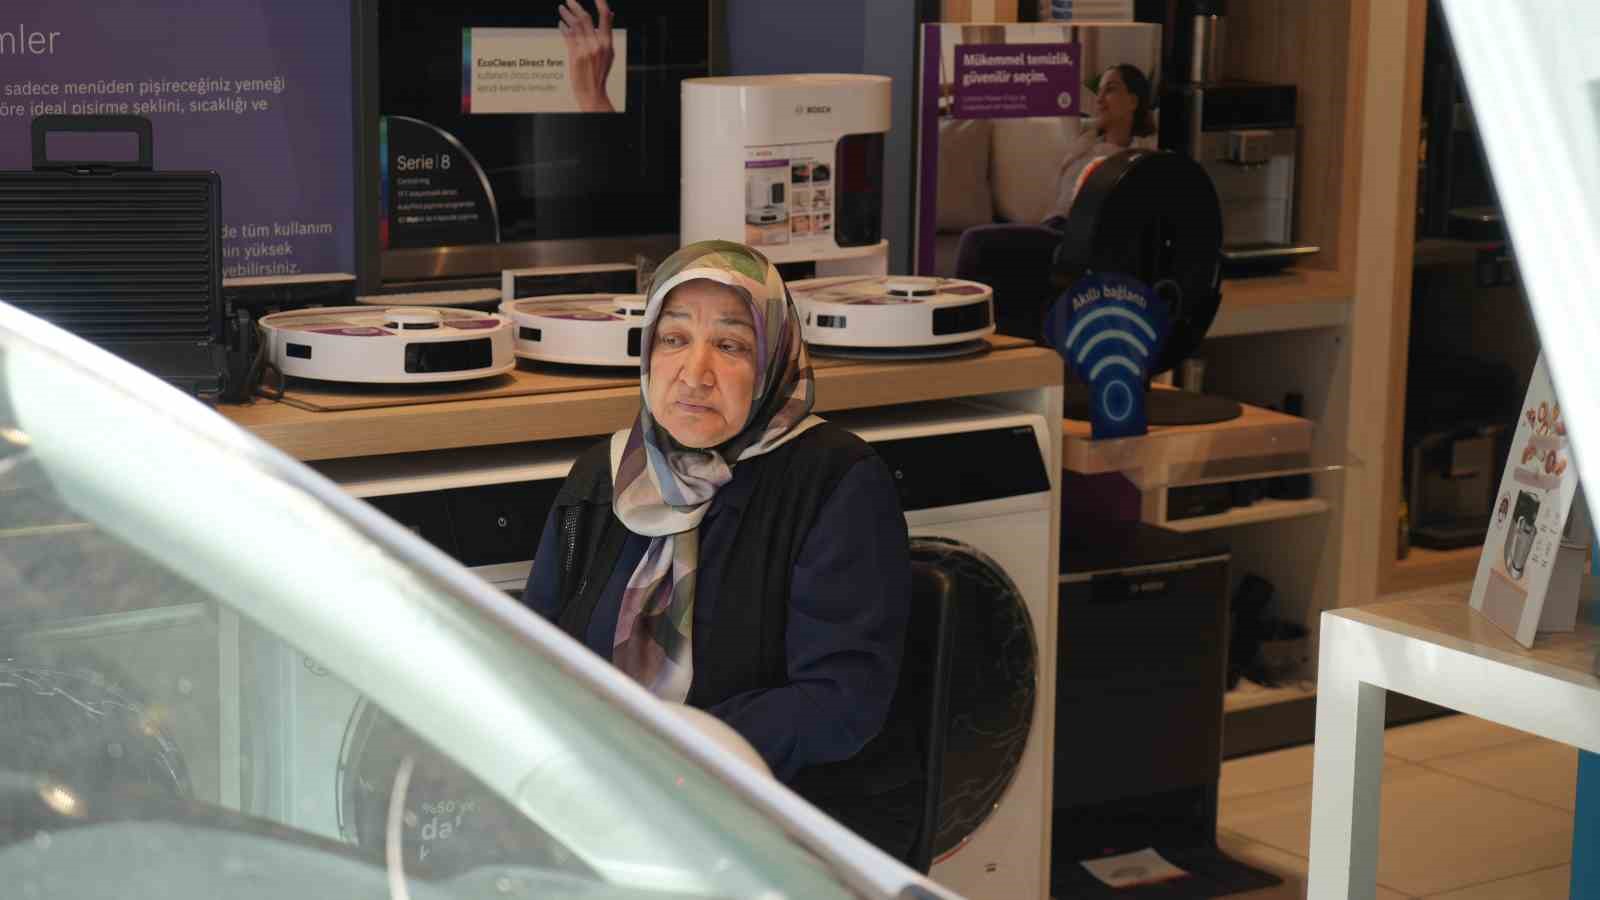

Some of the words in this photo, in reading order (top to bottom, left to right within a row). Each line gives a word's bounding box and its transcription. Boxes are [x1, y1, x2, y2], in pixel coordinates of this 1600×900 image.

[519, 57, 545, 68] Direct
[963, 52, 1025, 66] Mükemmel
[5, 80, 59, 96] sadece
[64, 79, 135, 95] menüden
[139, 77, 232, 97] pişireceğiniz
[234, 75, 286, 94] yemeği
[962, 70, 1011, 87] güvenilir
[1013, 69, 1048, 86] seçim.
[31, 99, 67, 116] ideal
[189, 96, 248, 114] sıcaklığı
[251, 98, 269, 111] ve
[397, 154, 434, 171] Serie
[440, 153, 452, 171] 8
[241, 222, 271, 239] tüm
[273, 220, 333, 237] kullanım
[243, 241, 293, 260] yüksek
